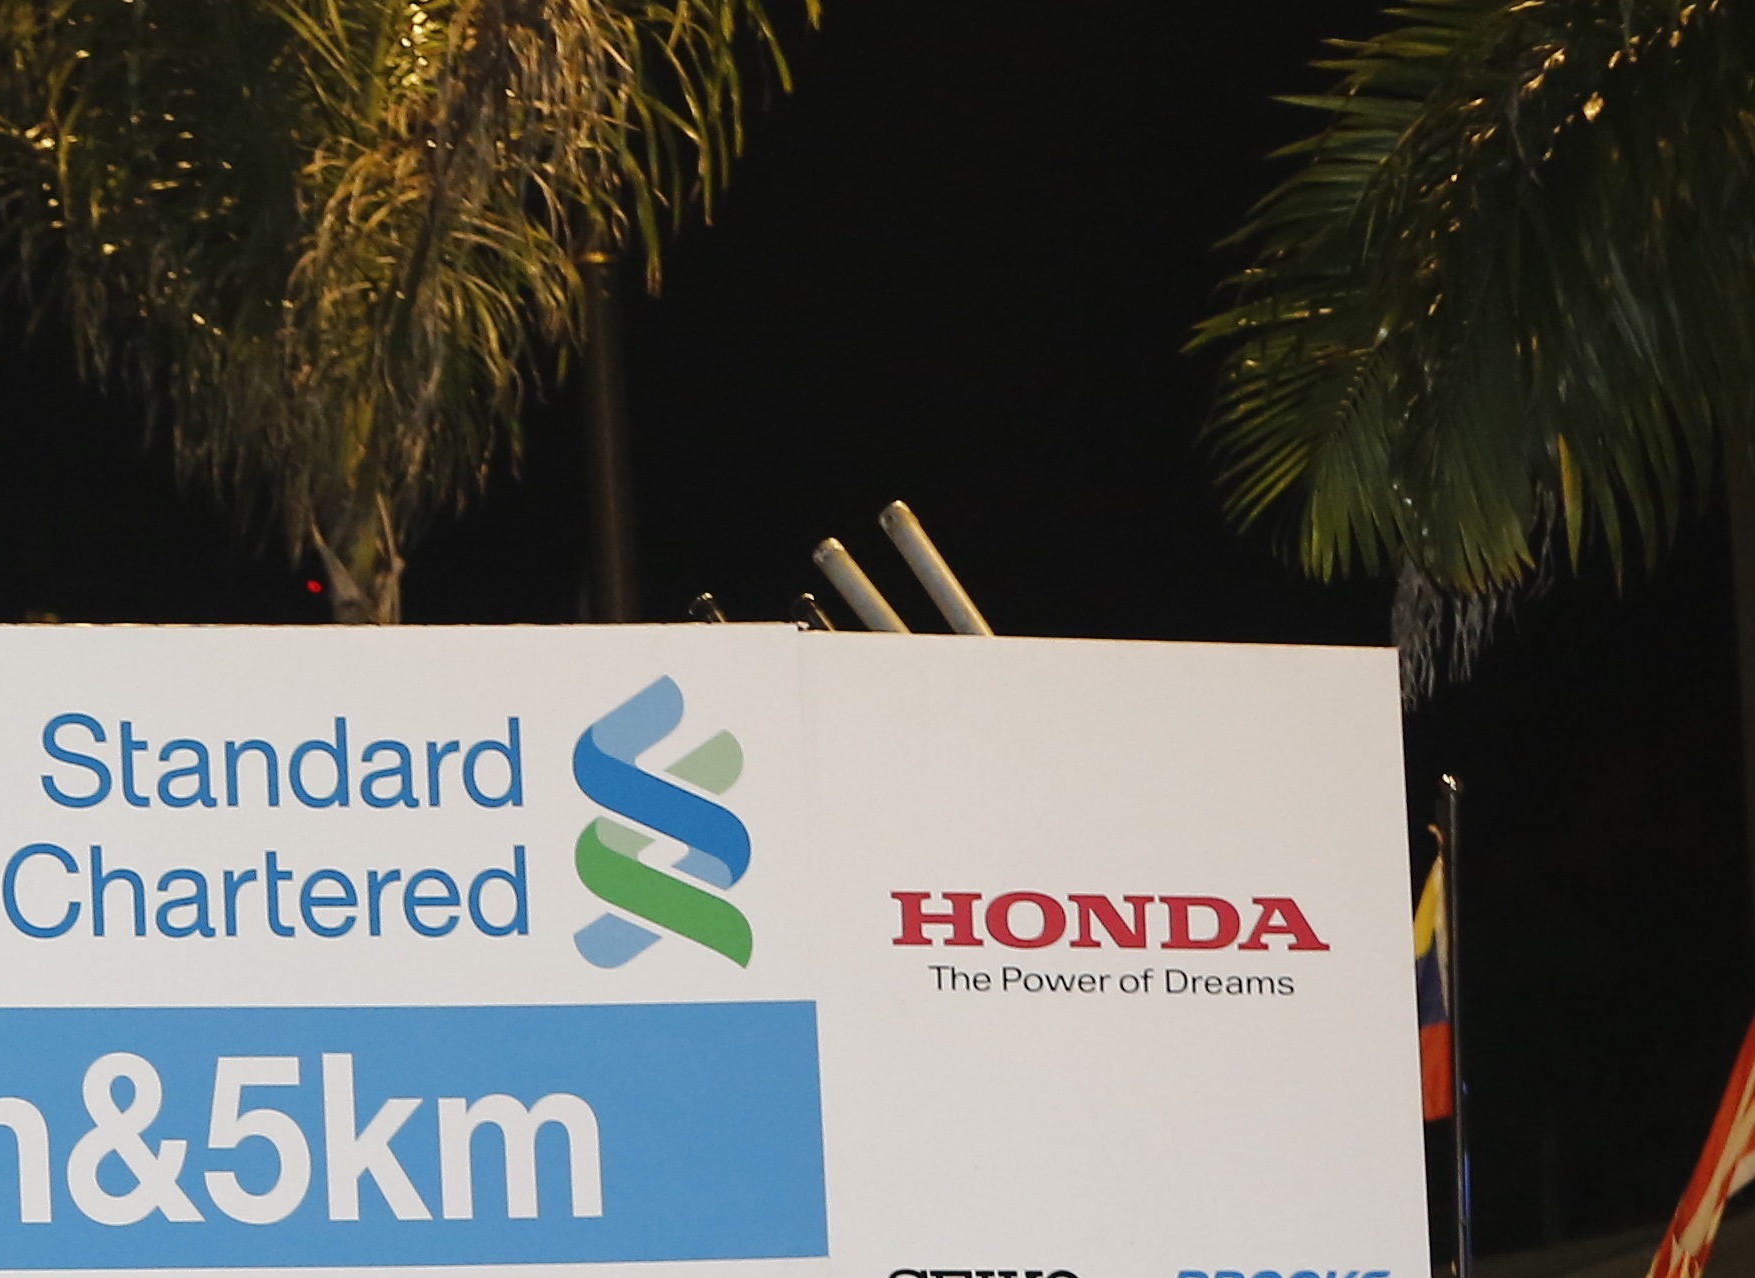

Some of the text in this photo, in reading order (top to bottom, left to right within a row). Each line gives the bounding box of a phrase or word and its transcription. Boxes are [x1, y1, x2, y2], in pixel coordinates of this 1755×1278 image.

[39, 713, 523, 811] Standard
[0, 843, 530, 942] Chartered
[891, 890, 1331, 952] HONDA
[928, 964, 1295, 997] The Power of Dreams
